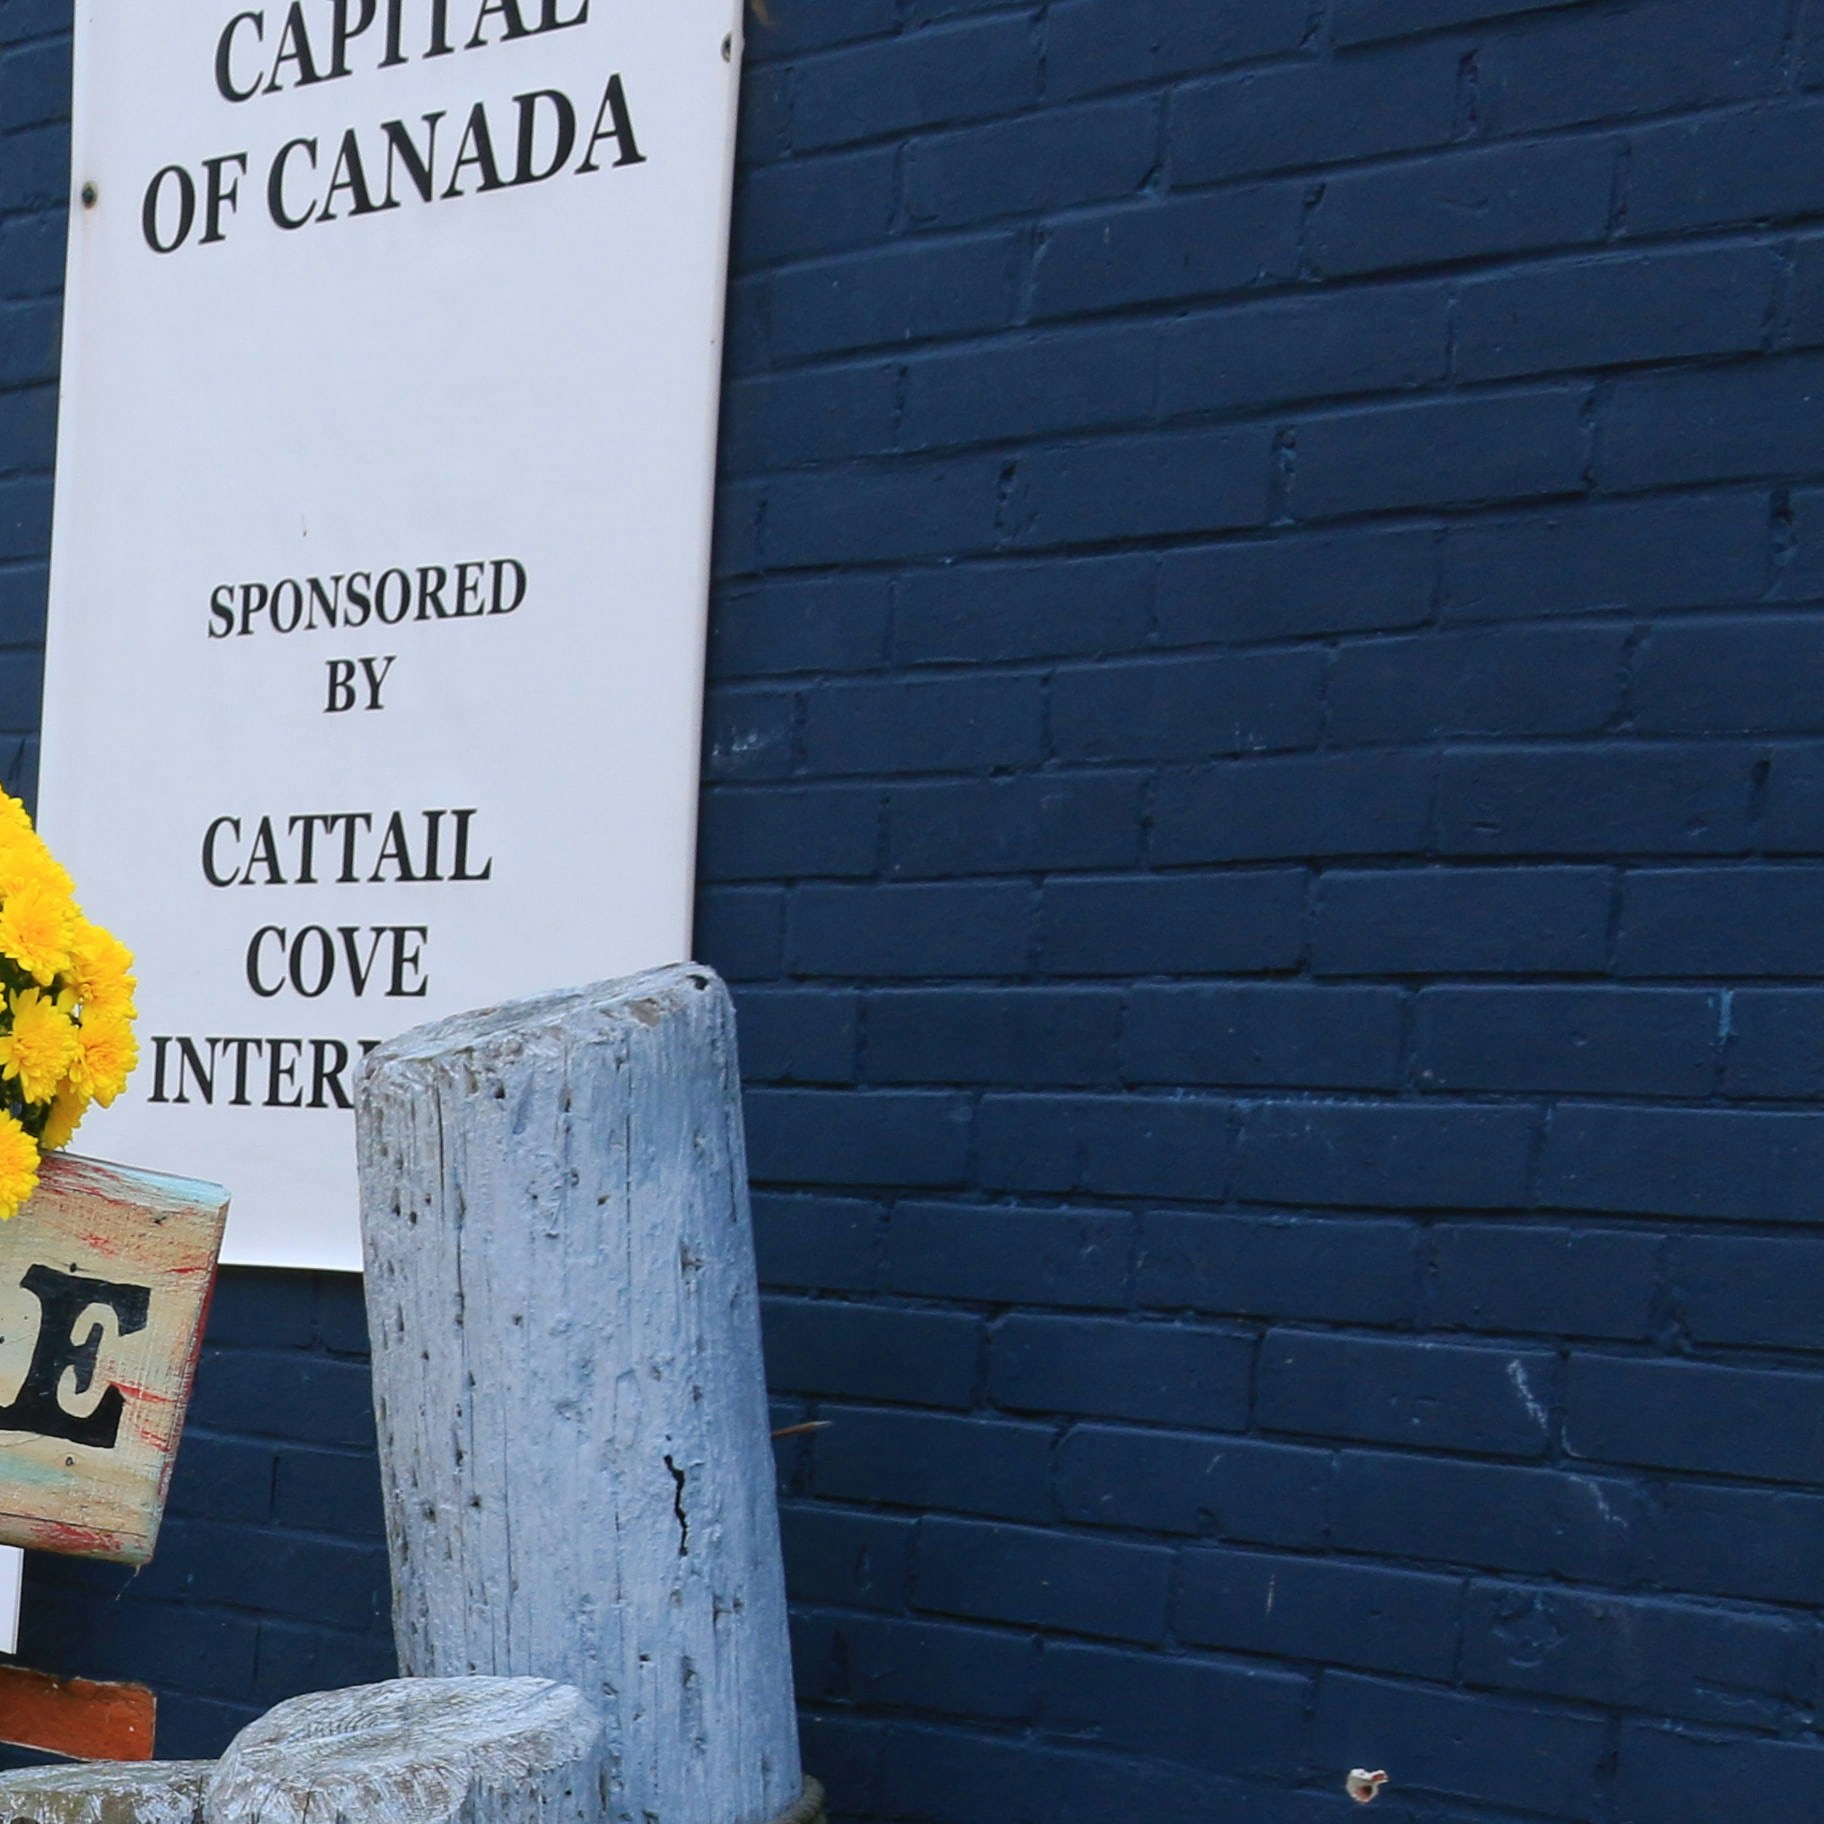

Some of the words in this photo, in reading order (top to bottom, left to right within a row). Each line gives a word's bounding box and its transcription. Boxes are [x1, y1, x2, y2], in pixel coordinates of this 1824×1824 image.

[141, 152, 248, 254] OF
[266, 72, 648, 231] CANADA
[207, 557, 528, 639] SPONSORED
[323, 655, 396, 714] BY
[201, 808, 493, 888] CATTAIL
[244, 926, 430, 998] COVE
[147, 1036, 383, 1109] INTER
